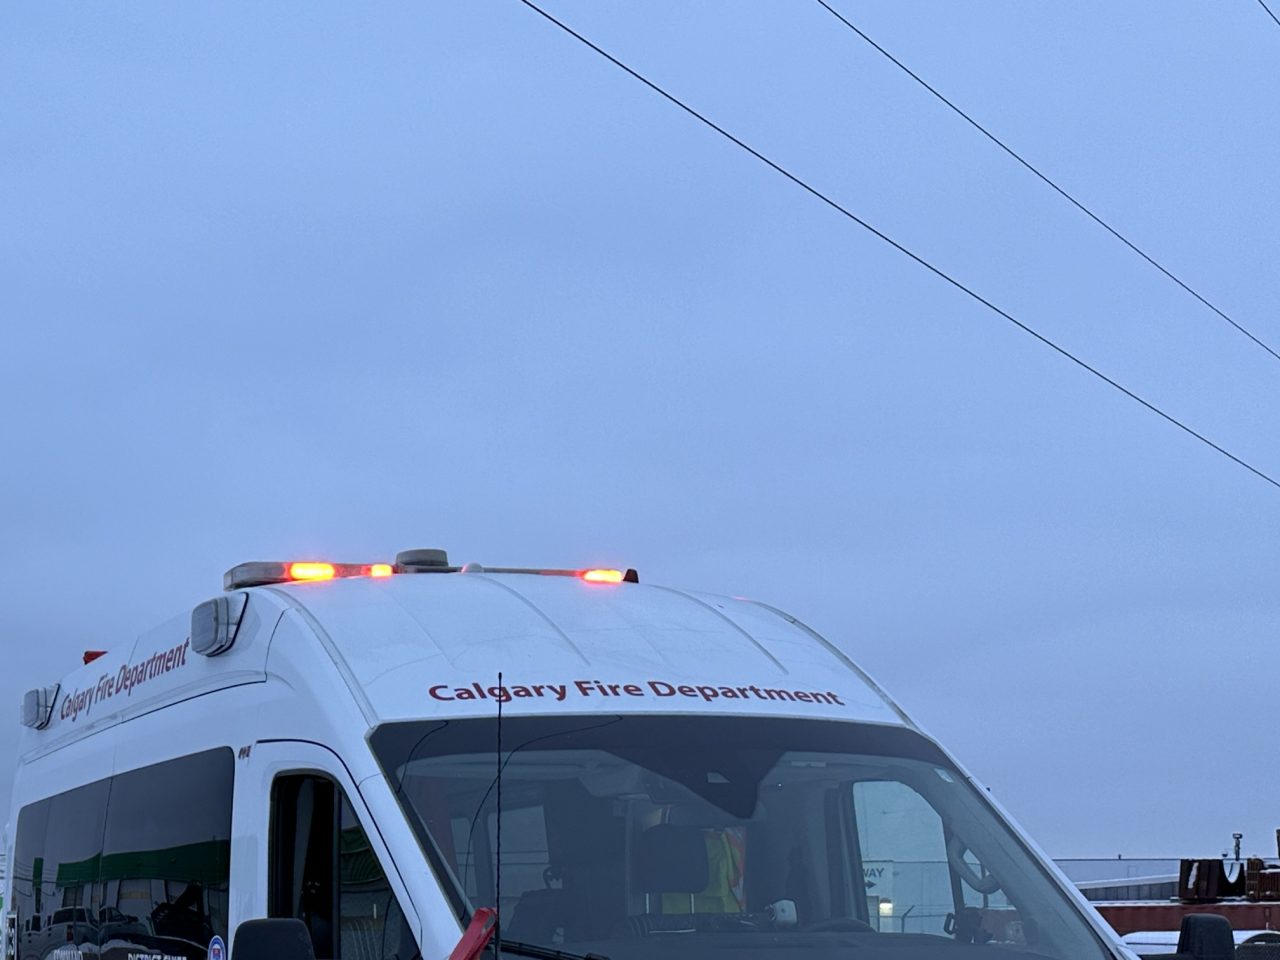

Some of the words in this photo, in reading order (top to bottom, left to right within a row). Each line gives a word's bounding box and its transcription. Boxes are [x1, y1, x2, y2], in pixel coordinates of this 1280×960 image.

[61, 688, 95, 722] Calgary
[95, 673, 115, 704] Fire
[115, 637, 190, 697] Department
[428, 682, 566, 702] Calgary
[574, 680, 645, 697] Fire
[647, 680, 845, 706] Department
